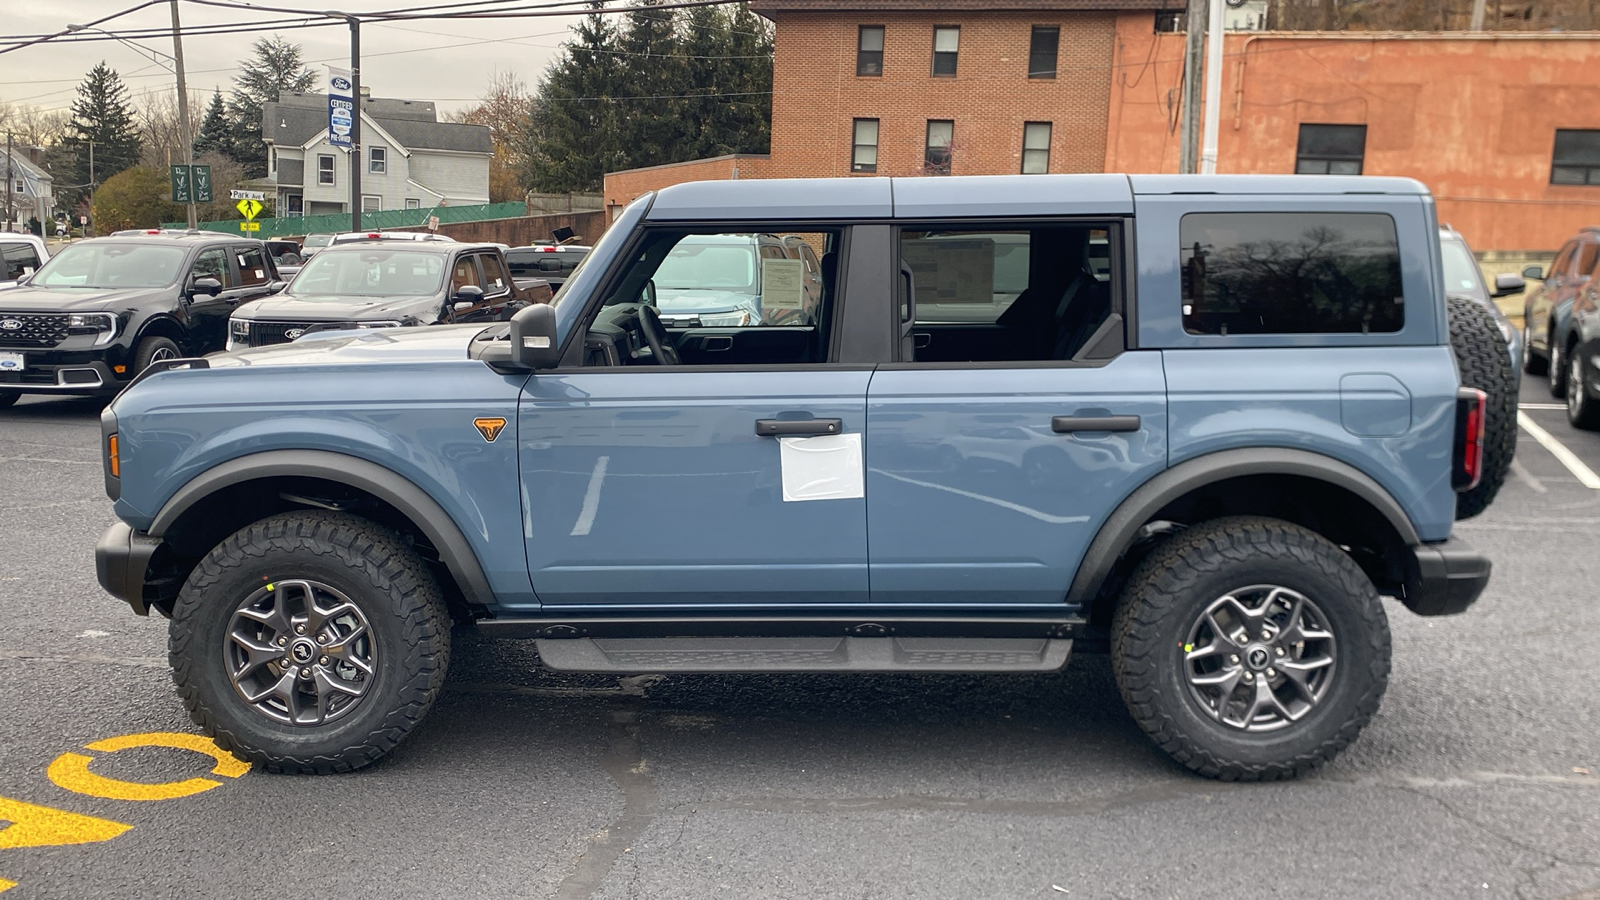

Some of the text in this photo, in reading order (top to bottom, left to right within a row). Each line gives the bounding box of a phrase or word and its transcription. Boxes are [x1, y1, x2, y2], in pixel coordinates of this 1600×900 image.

[330, 99, 352, 110] CERTIFIED
[330, 133, 350, 143] PRE-OWNED
[233, 190, 249, 199] Park
